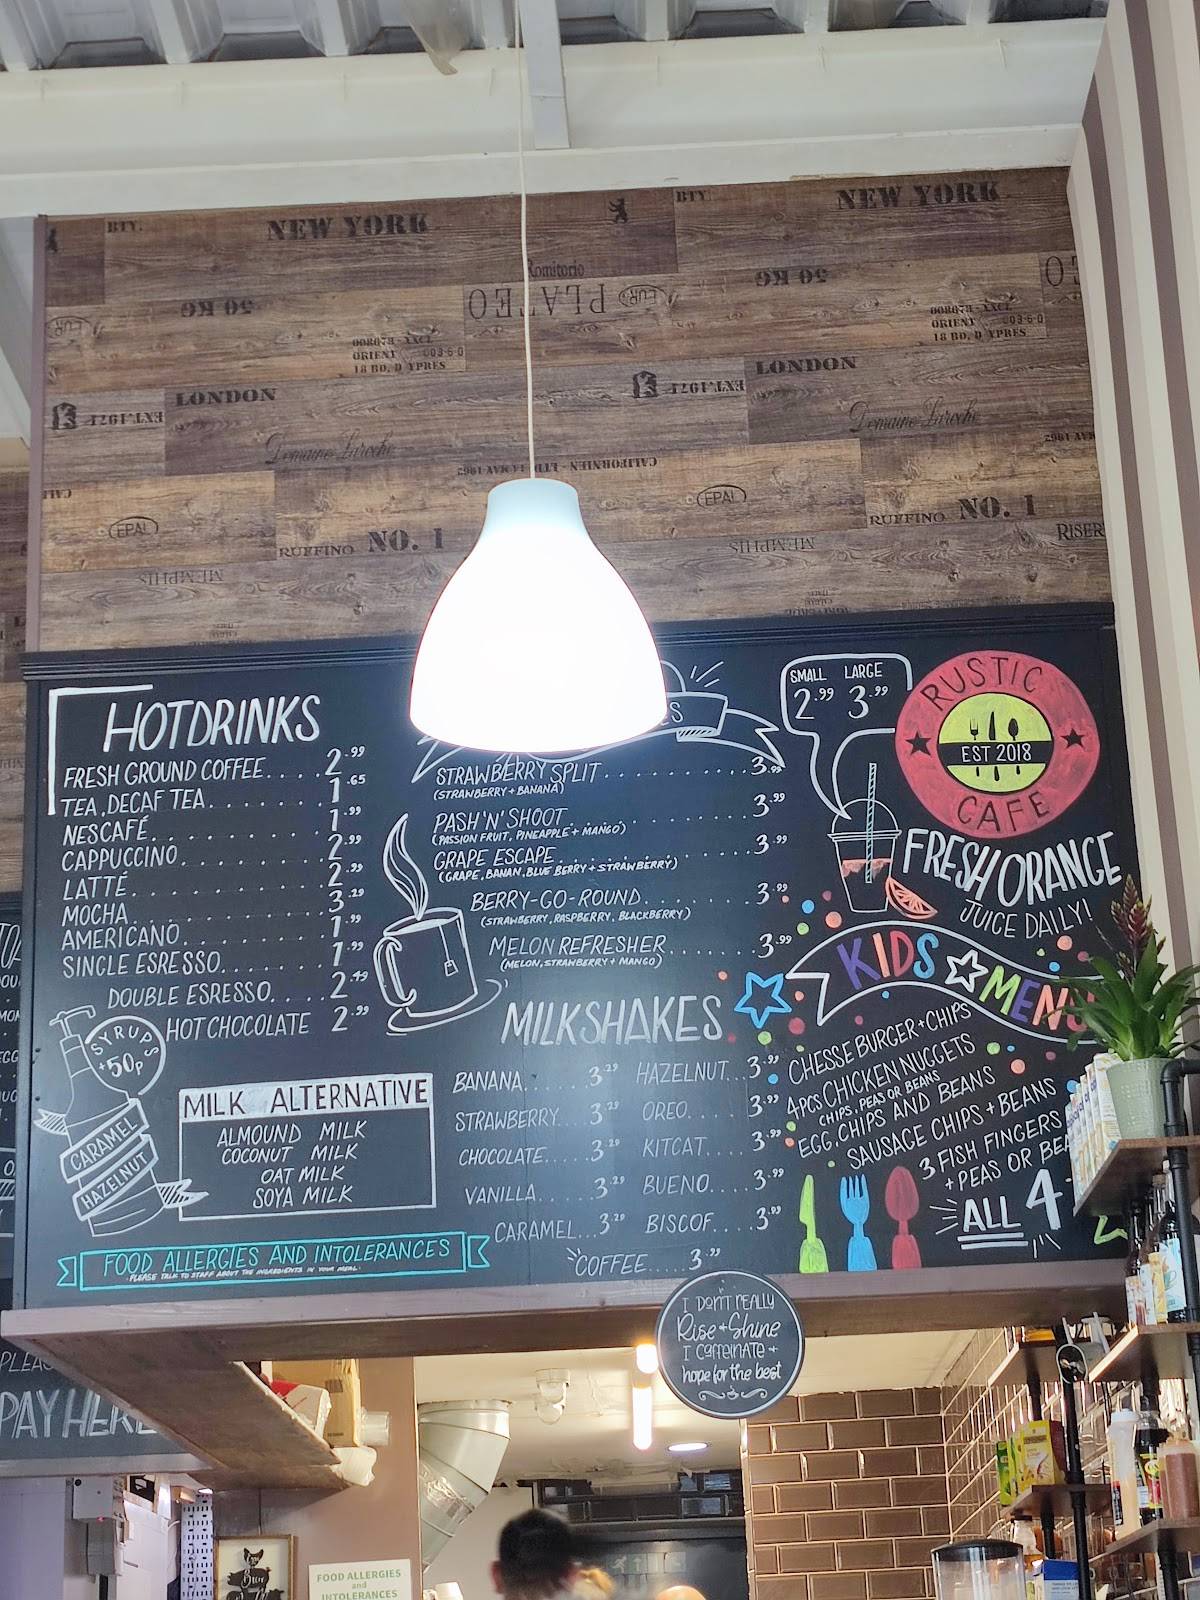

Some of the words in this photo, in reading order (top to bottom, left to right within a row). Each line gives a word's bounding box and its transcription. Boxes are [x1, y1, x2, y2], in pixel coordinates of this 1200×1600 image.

[837, 186, 901, 210] NEW
[914, 181, 1001, 205] YORK
[268, 216, 334, 240] NEW
[344, 213, 428, 237] YORK
[756, 356, 858, 374] LONDON
[176, 388, 278, 407] LONDON
[870, 512, 945, 526] RUFFINO
[959, 495, 1010, 520] NO.
[279, 545, 354, 558] RUFFINO
[368, 528, 419, 552] NO.
[790, 668, 828, 684] SMALL
[844, 662, 883, 679] LARGE
[920, 656, 1044, 711] RUSTIC
[960, 746, 990, 762] EST
[995, 744, 1032, 762] 2018
[63, 764, 120, 789] FRESH
[124, 760, 196, 786] GROUND
[201, 757, 266, 780] COFFEE
[436, 760, 546, 786] STRAWBERRY
[550, 762, 602, 784] SPLIT
[108, 790, 165, 816] DECAF
[170, 788, 205, 810] TEA
[434, 786, 506, 800] (STRAWBERRY
[516, 782, 564, 796] BANANA)
[434, 810, 480, 833] PASH
[506, 807, 568, 828] SHOOT
[957, 792, 1050, 832] CAFE
[62, 815, 150, 847] NESCAFÉ
[432, 832, 478, 846] (PASSION
[480, 832, 512, 843] FRUIT,
[516, 826, 569, 840] PINEAPPLE
[582, 823, 626, 836] MANGO)
[62, 844, 178, 872] CAPPUCCINO
[434, 848, 488, 871] GRAPE
[493, 846, 556, 866] ESCAPE
[554, 864, 588, 877] BERRY
[597, 858, 678, 873] STRAWBERRY)
[902, 828, 1000, 901] FRESH
[998, 831, 1122, 907] ORANGE
[63, 871, 128, 901] LATTÉ
[62, 902, 128, 928] MOCHA
[554, 911, 614, 924] RASPBERRY,
[618, 906, 692, 922] BLACKBERRY)
[959, 898, 1018, 938] JUICE
[1025, 898, 1094, 939] DAILY!
[61, 923, 180, 951] AMERICANO
[489, 935, 554, 957] MELON
[558, 934, 666, 956] REFRESHER
[135, 950, 220, 976] ESRESSO
[618, 954, 662, 969] MANGO)
[836, 930, 940, 991] KIDS
[108, 986, 180, 1009] DOUBLE
[186, 980, 271, 1006] ESRESSO
[165, 1016, 206, 1042] HOT
[206, 1012, 312, 1038] CHOCOLATE
[500, 994, 722, 1046] MILKSHAKES
[90, 1025, 160, 1057] SYRUPS
[636, 1060, 729, 1084] HAZELNUT
[788, 1040, 855, 1085] CHESSE
[822, 1060, 900, 1108] CHICKEN
[900, 1032, 976, 1076] NUGGETS
[452, 1070, 522, 1094] BANANA
[858, 1091, 886, 1112] PEAS
[887, 1085, 902, 1100] OR
[904, 1069, 940, 1094] BEANS
[184, 1090, 246, 1118] MILK
[270, 1078, 428, 1114] ALTERNATIVE
[642, 1100, 688, 1122] OREO
[838, 1108, 886, 1142] CHIPS
[892, 1092, 930, 1121] AND
[938, 1065, 996, 1104] BEANS
[455, 1106, 560, 1132] STRAWBERRY
[847, 1124, 928, 1170] SAUSAGE
[931, 1104, 984, 1141] CHIPS
[998, 1077, 1058, 1117] BEANS
[70, 1116, 138, 1171] CARAMEL
[216, 1123, 302, 1148] ALMOUND
[319, 1120, 368, 1140] MILK
[642, 1136, 707, 1158] KITCAT
[918, 1156, 936, 1180] 3
[936, 1139, 978, 1173] FISH
[983, 1110, 1063, 1149] FINGERS
[221, 1146, 294, 1164] COCONUT
[310, 1143, 359, 1160] MILK
[458, 1146, 548, 1167] CHOCOLATE
[958, 1159, 1002, 1192] PEAS
[1008, 1148, 1033, 1173] OR
[1039, 1133, 1070, 1164] BEA
[80, 1151, 148, 1210] HAZELNUT
[260, 1167, 295, 1184] OAT
[298, 1165, 346, 1184] MILK
[642, 1174, 710, 1196] BUENO
[253, 1186, 294, 1209] SOYA
[302, 1184, 353, 1205] MILK
[464, 1184, 536, 1206] VANILLA
[645, 1211, 714, 1234] BISCOF
[964, 1195, 1022, 1232] ALL
[494, 1218, 577, 1244] CARAMEL
[104, 1252, 154, 1277] FOOD
[162, 1245, 259, 1274] ALLERGIES
[268, 1244, 307, 1265] AND
[314, 1238, 450, 1264] INTOLERANCES
[575, 1253, 648, 1277] COFFEE
[676, 1313, 717, 1342] Rise
[728, 1312, 782, 1340] Shine
[682, 1364, 711, 1386] hope
[712, 1364, 726, 1384] for
[730, 1363, 752, 1382] the
[756, 1360, 782, 1380] best
[0, 1388, 60, 1439] PAY
[316, 1572, 345, 1583] FOOD
[347, 1568, 402, 1580] ALLERGIES
[352, 1582, 367, 1590] and
